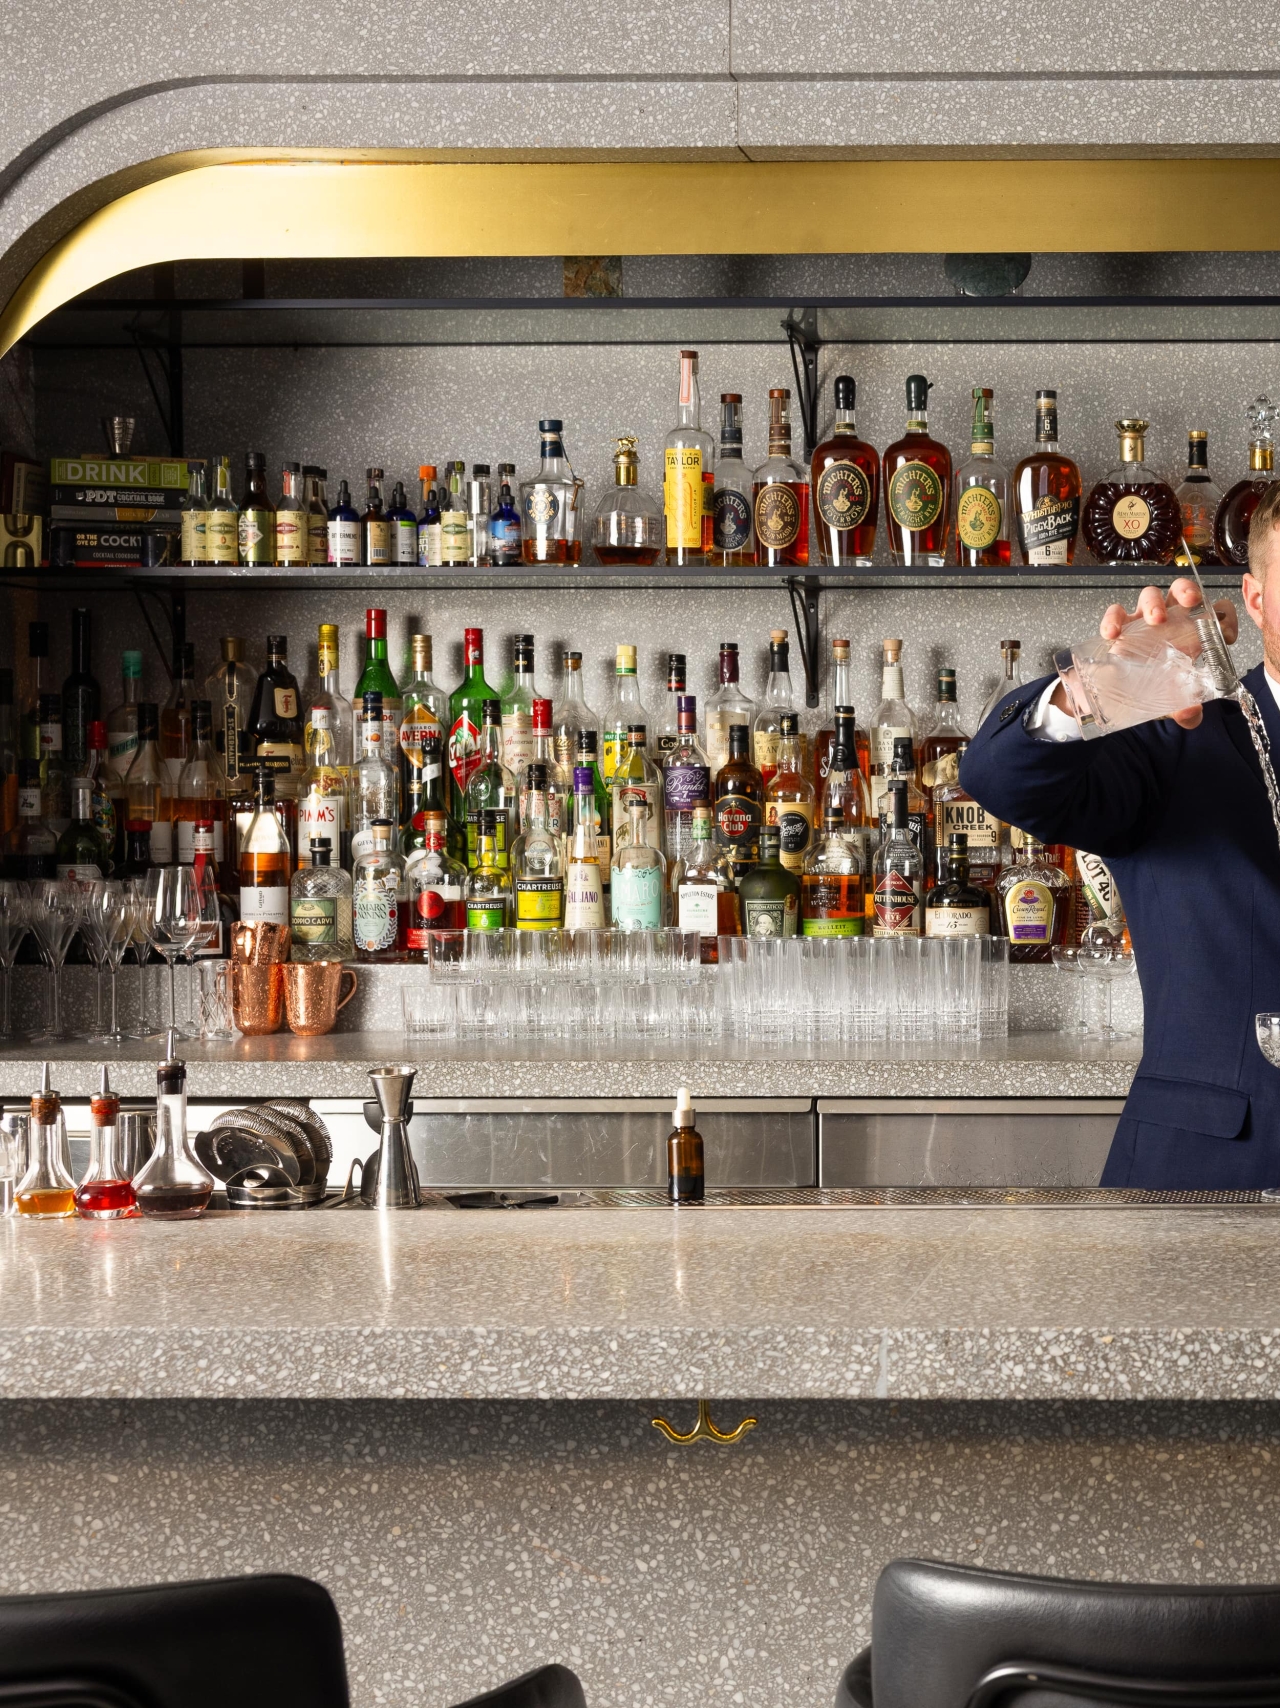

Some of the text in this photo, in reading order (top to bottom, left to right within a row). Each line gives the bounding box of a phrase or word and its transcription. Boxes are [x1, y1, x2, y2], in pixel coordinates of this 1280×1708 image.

[1044, 419, 1050, 430] 6
[667, 456, 699, 465] TAYLOR
[67, 463, 145, 483] DRINK
[823, 470, 862, 495] MICHTER'S
[895, 470, 935, 495] MICHTER'S
[85, 490, 117, 502] PDT
[117, 493, 146, 502] COCKTAIL
[148, 495, 165, 503] BOOK
[760, 492, 794, 515] MICHTER'S
[961, 494, 996, 515] MICHTER'S
[824, 504, 862, 522] BOURBON
[896, 504, 935, 522] STRAIGHT RYE
[1123, 519, 1141, 529] XO
[762, 525, 792, 539] SOUR MASH
[961, 525, 986, 542] STRAIGHT
[1045, 546, 1050, 556] 6
[402, 731, 442, 742] AVERNA
[666, 777, 704, 792] Banks
[718, 812, 752, 822] Havana
[946, 807, 985, 823] KNOB
[724, 821, 744, 831] Club
[991, 831, 997, 842] 9
[730, 845, 738, 855] 7
[1081, 852, 1106, 882] LOT
[517, 883, 562, 891] CHARTREUSE
[681, 891, 715, 900] APPLETON ESTATE
[358, 903, 386, 911] AMARO
[1013, 905, 1028, 913] Crown
